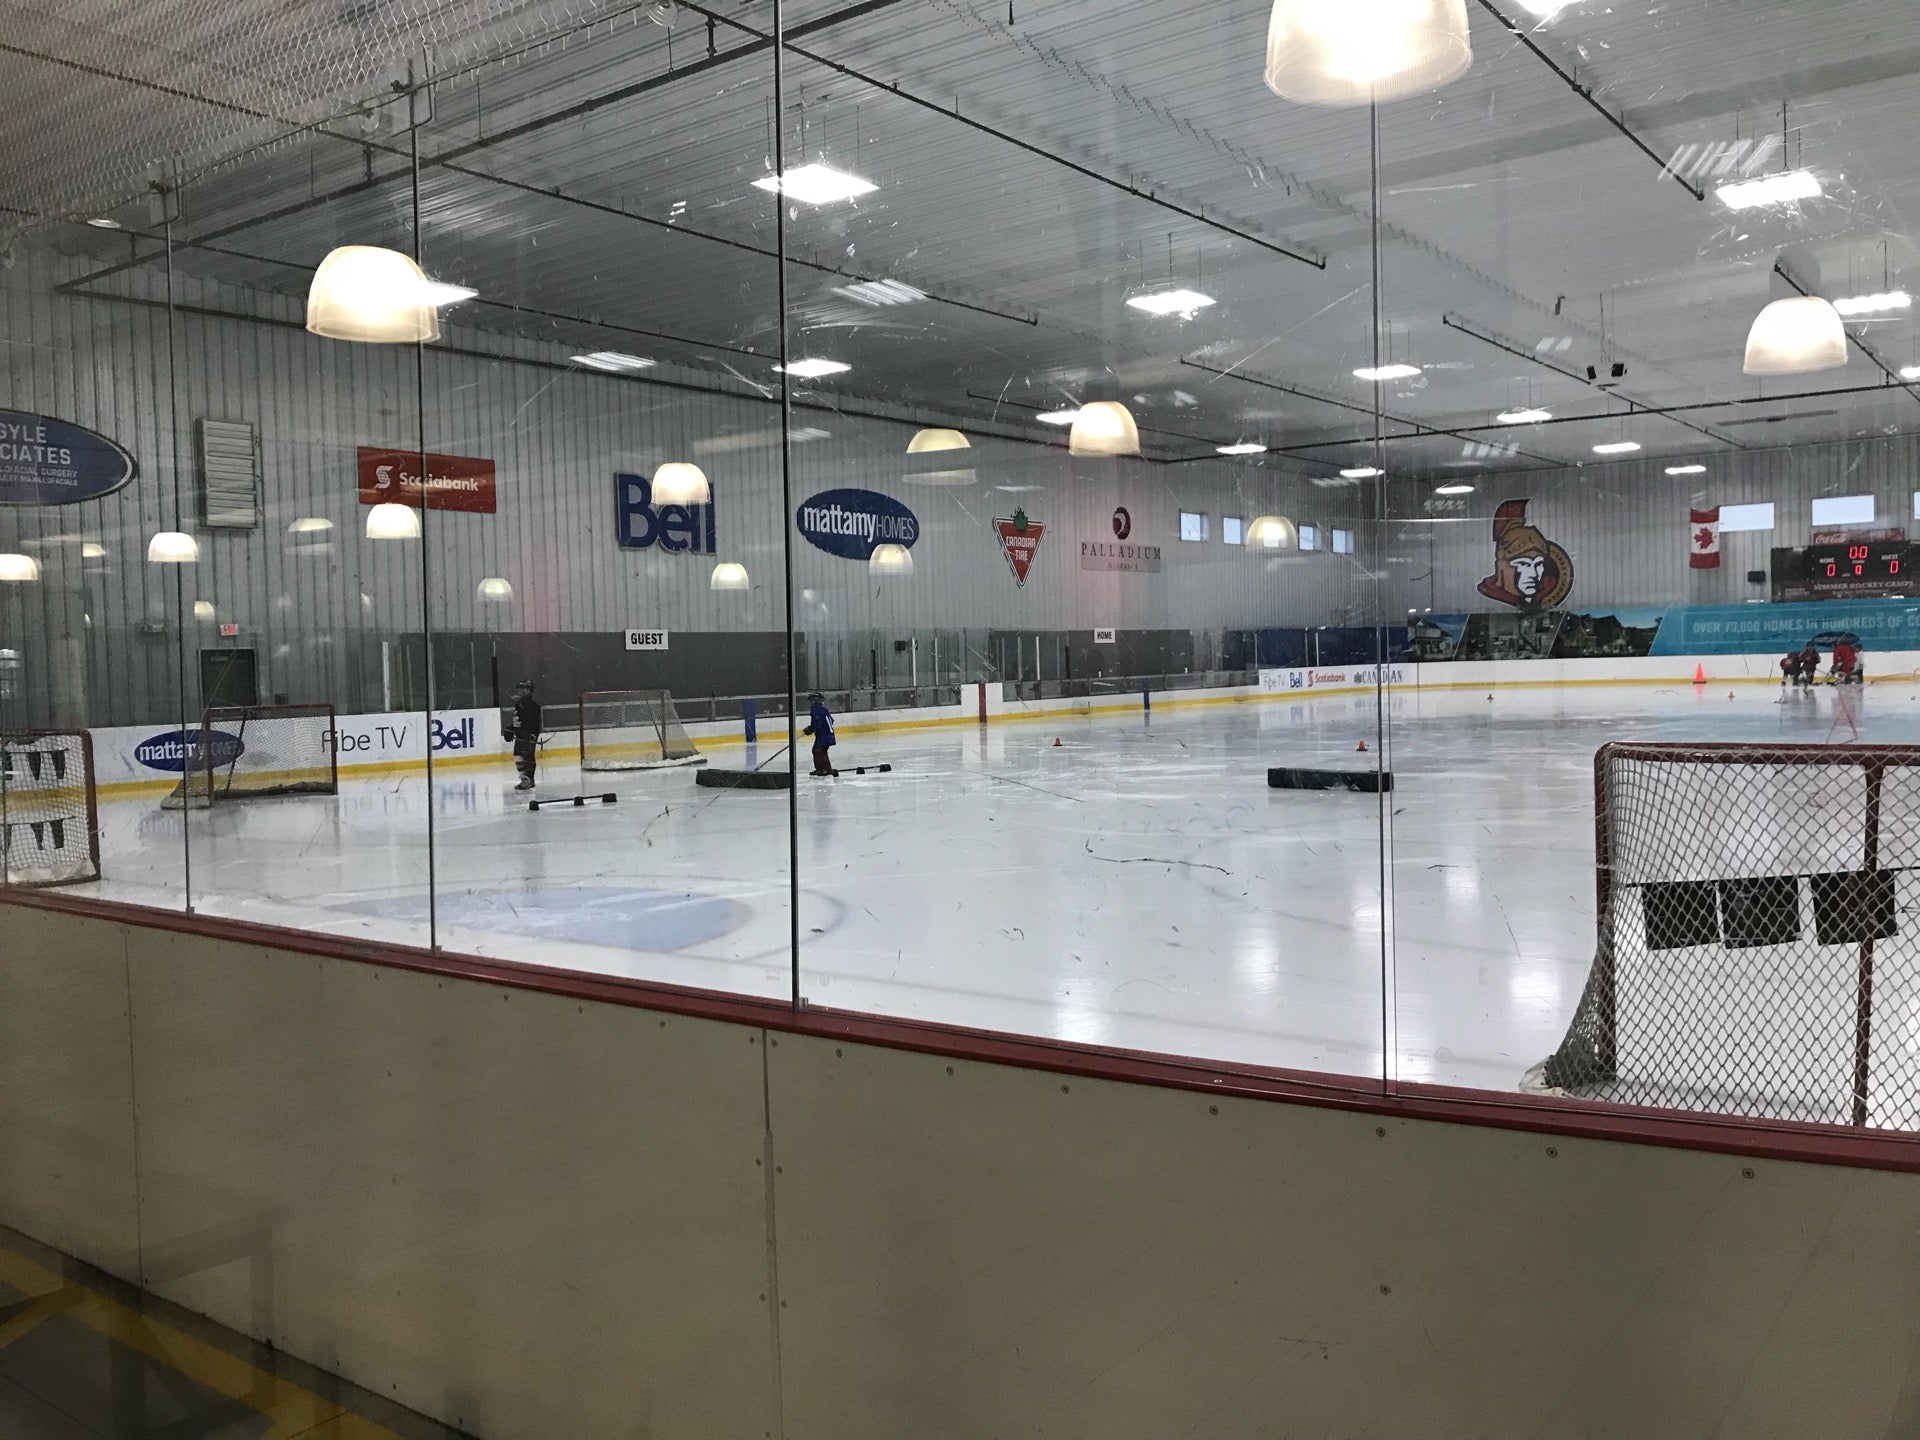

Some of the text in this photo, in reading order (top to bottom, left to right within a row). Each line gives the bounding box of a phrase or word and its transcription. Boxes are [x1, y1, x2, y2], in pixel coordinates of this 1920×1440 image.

[0, 443, 71, 465] CIATES
[617, 473, 716, 554] Bell
[1005, 535, 1036, 548] CANADIAN
[1015, 549, 1028, 561] TIRE
[1081, 542, 1161, 560] PALLADIUM
[1693, 619, 1720, 633] OVER
[1763, 619, 1801, 632] HOMES
[1822, 616, 1884, 630] HUNDREDS
[631, 632, 663, 645] GUEST
[1097, 631, 1112, 640] HOME
[1290, 672, 1303, 688] Bell
[1362, 669, 1403, 684] CANDAN
[321, 726, 407, 752] Fibe TV
[431, 717, 474, 750] Bell
